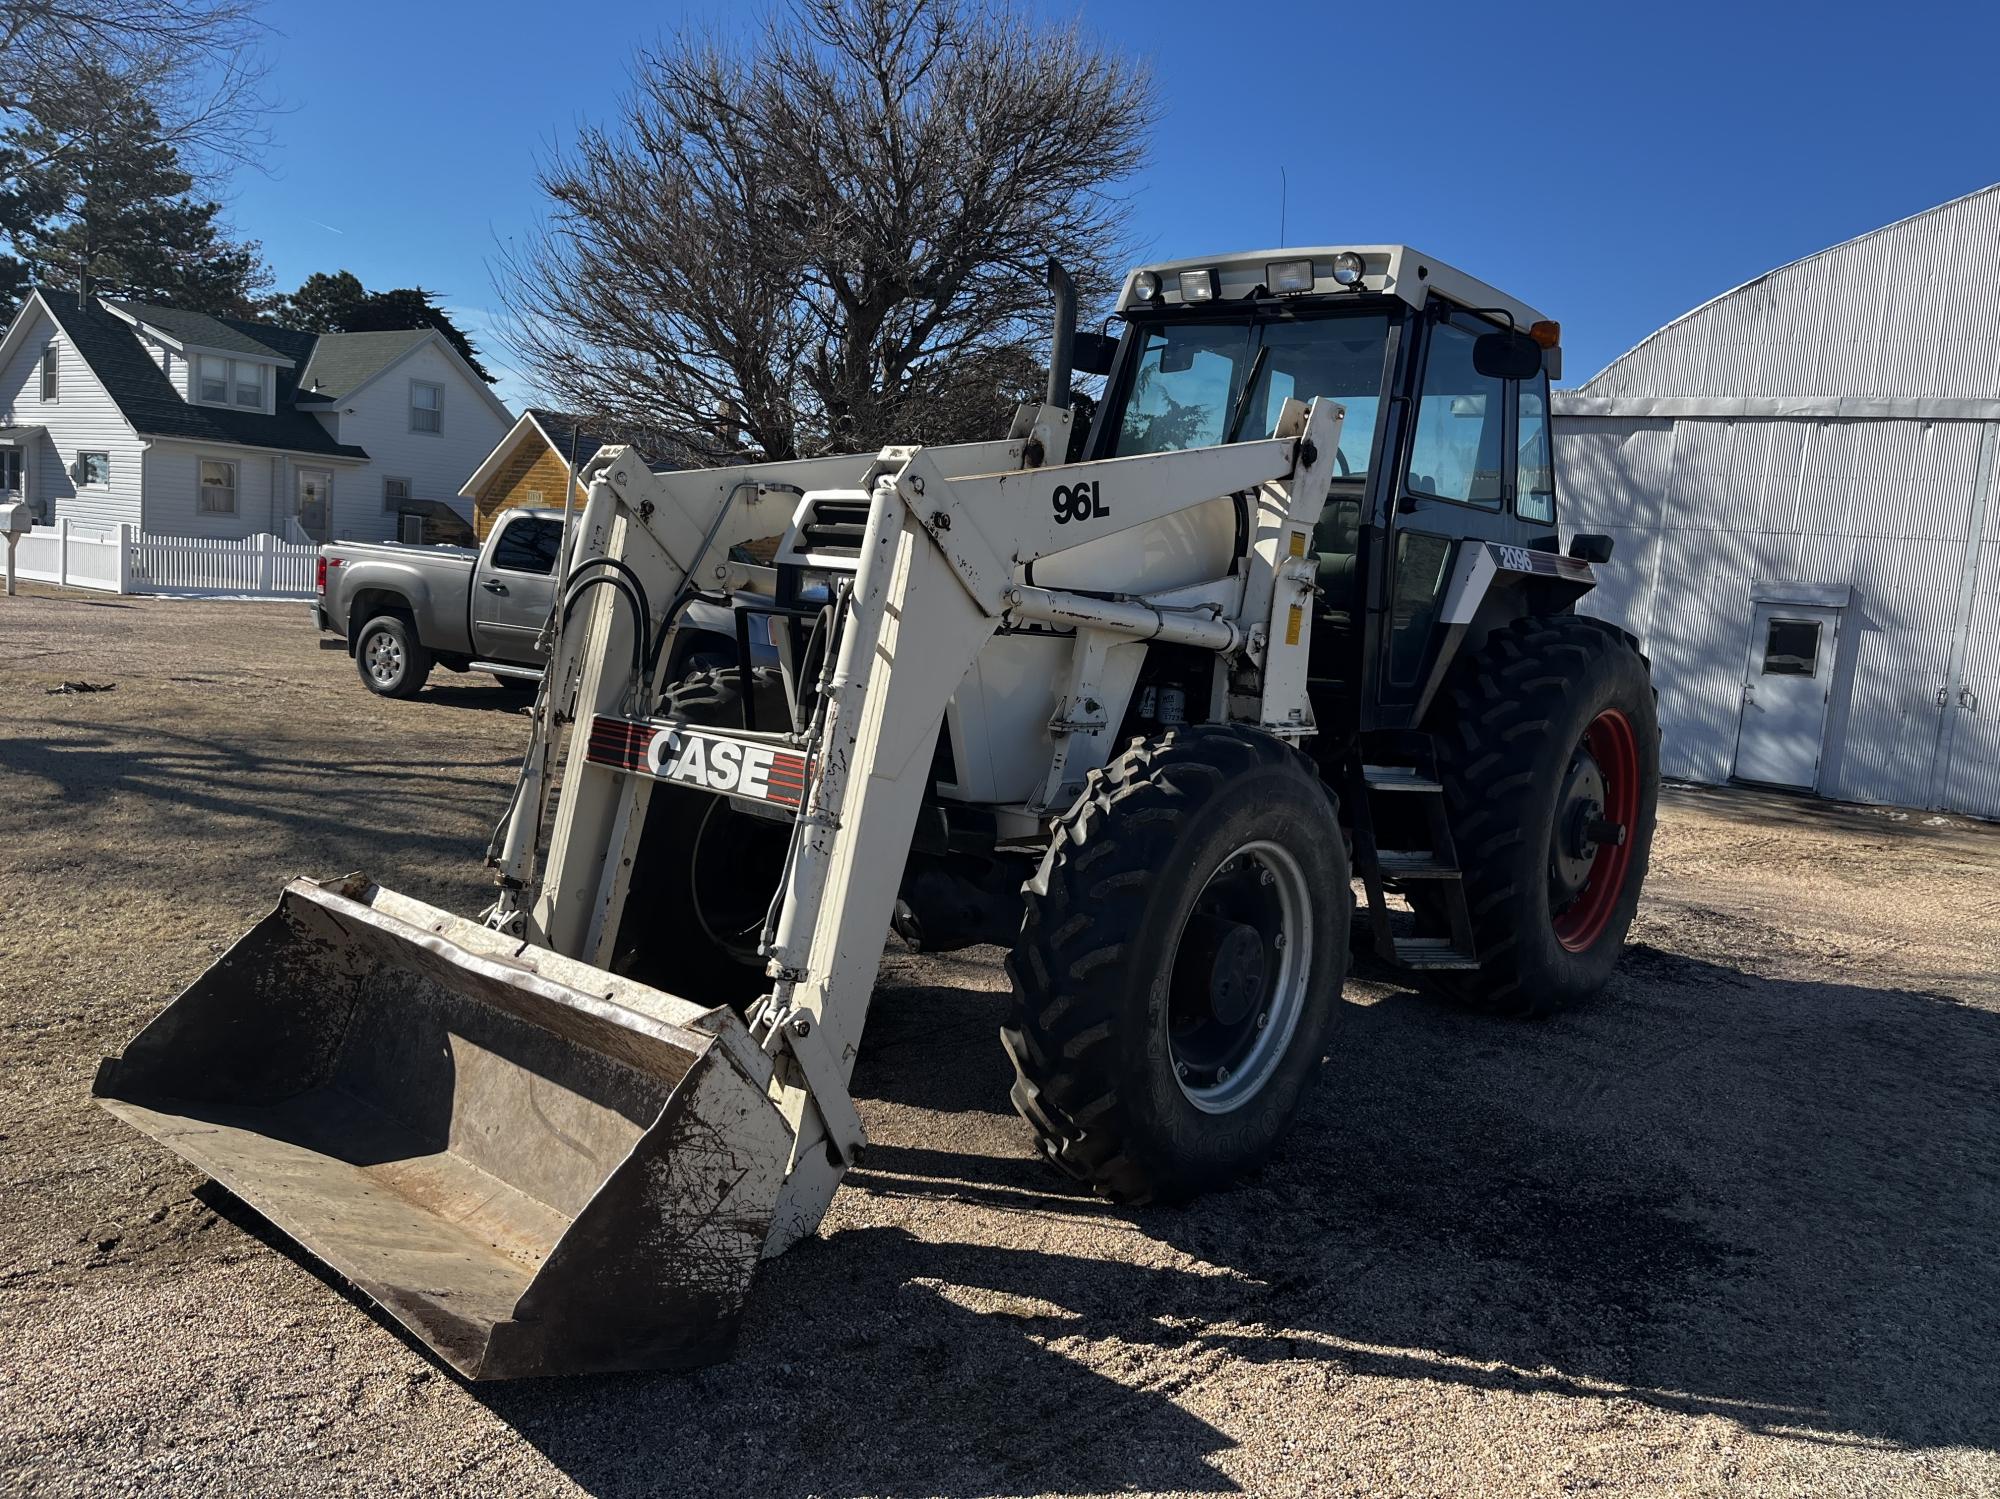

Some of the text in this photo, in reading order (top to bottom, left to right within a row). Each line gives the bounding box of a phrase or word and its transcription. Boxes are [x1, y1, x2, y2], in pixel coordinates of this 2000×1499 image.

[1052, 480, 1110, 525] 96L
[1500, 546, 1533, 571] 2096
[647, 730, 775, 799] CASE
